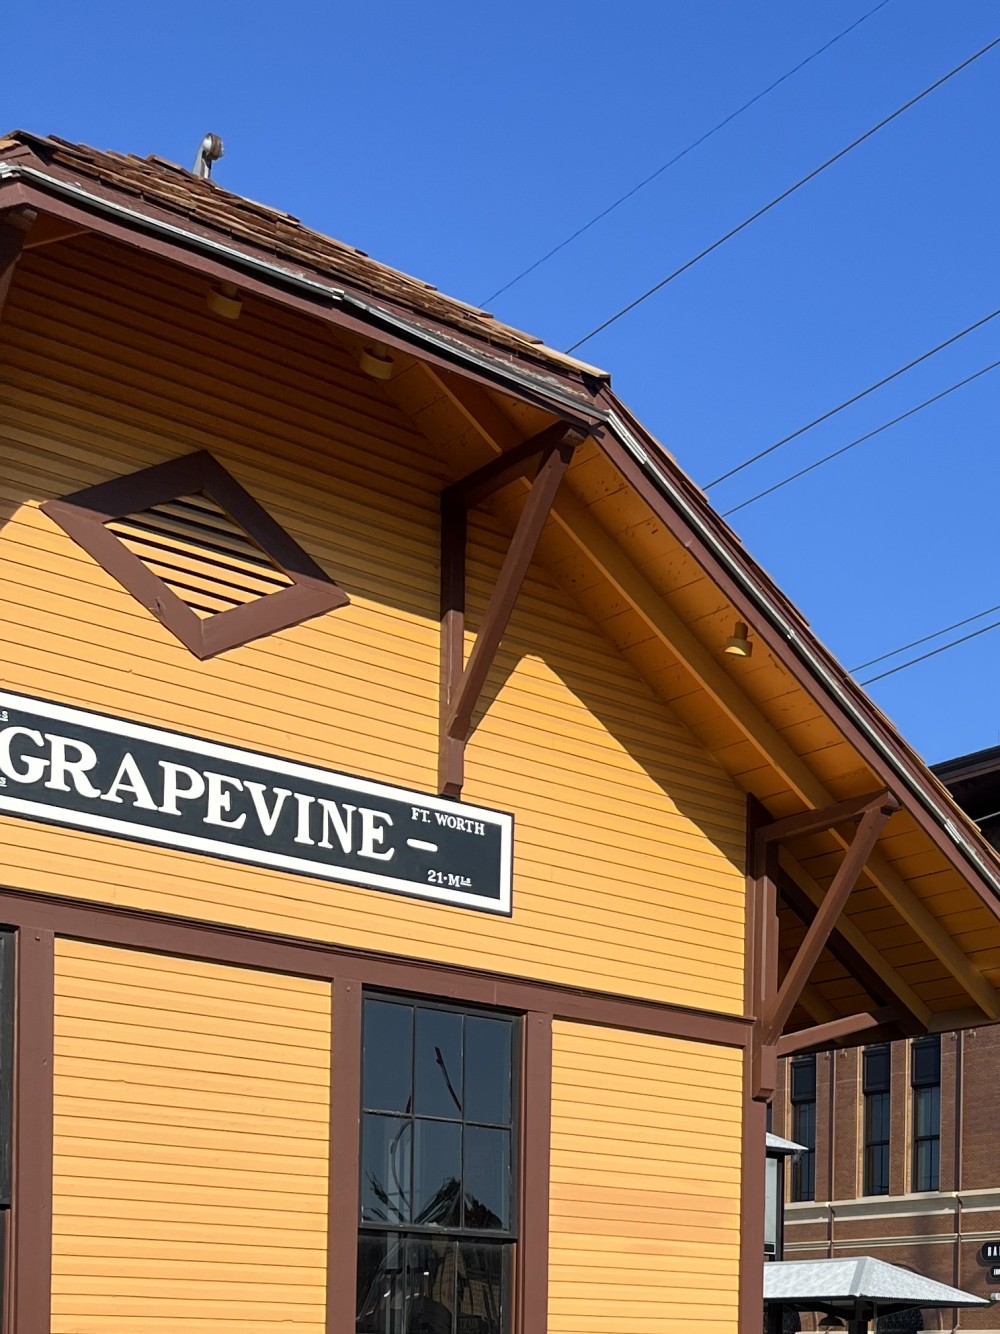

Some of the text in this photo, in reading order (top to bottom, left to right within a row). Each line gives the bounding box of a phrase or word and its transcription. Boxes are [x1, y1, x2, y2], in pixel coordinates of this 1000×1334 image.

[0, 726, 396, 861] GRAPEVINE
[411, 807, 485, 836] FT. WORTH
